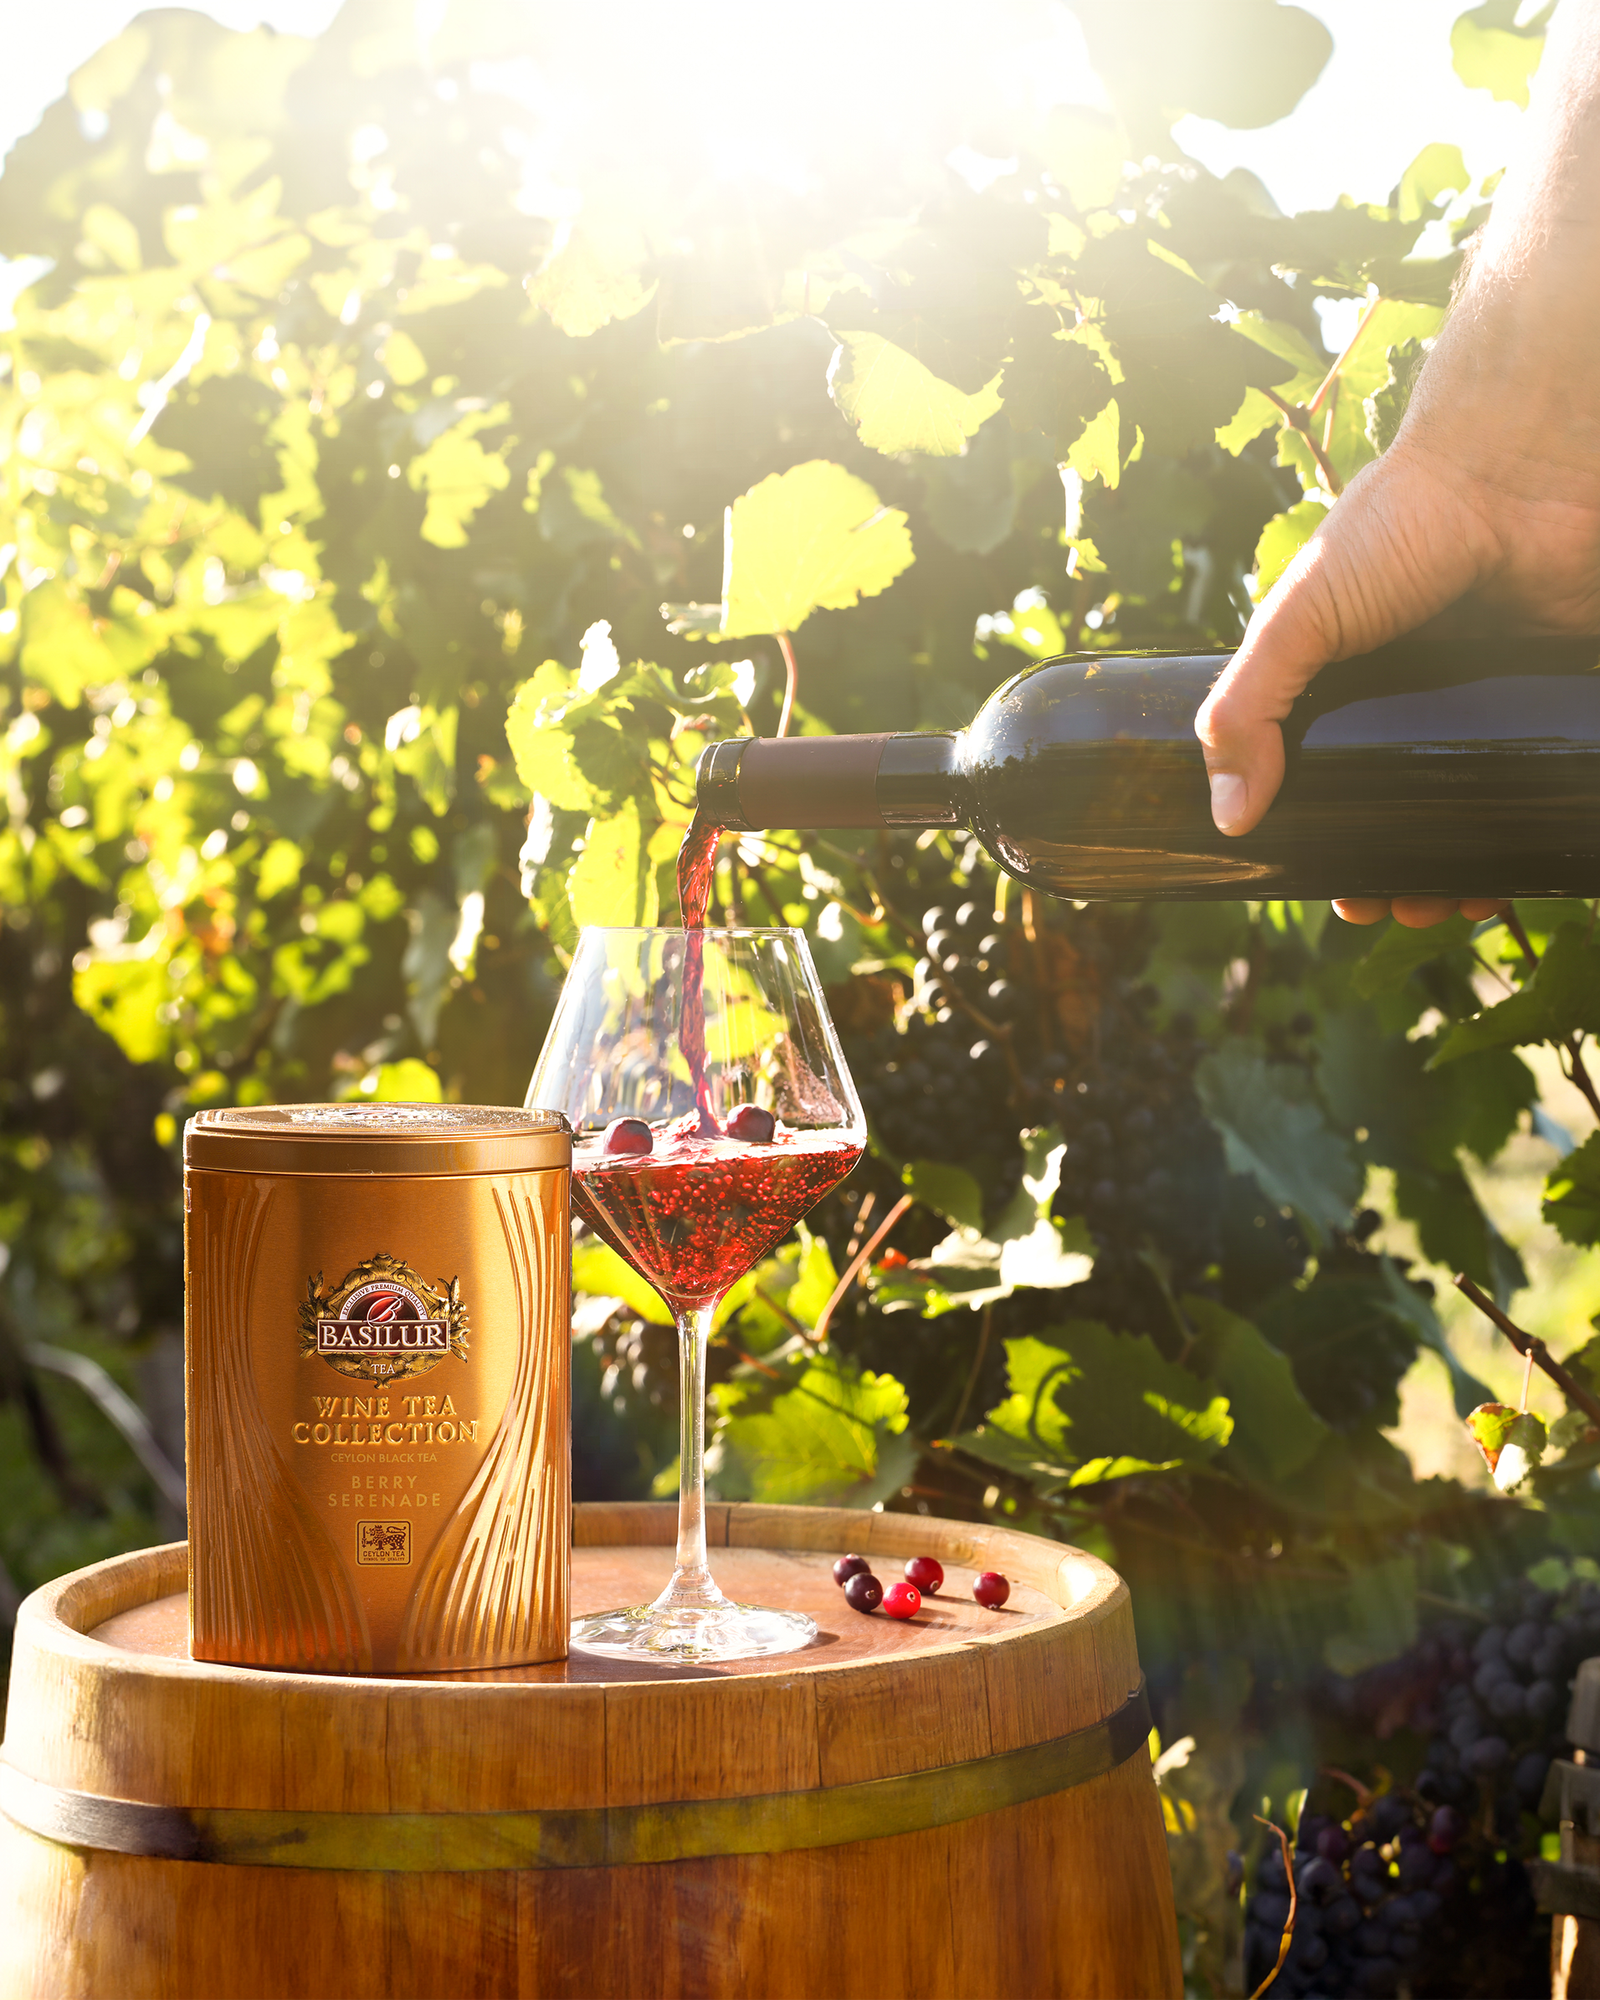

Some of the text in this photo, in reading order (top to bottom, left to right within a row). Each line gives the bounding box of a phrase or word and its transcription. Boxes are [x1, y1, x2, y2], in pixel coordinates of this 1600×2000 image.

[342, 1283, 426, 1316] EXCLUSIVE PREMIUM QUALITY
[321, 1324, 445, 1347] BASILUR
[371, 1364, 395, 1374] TEA
[312, 1394, 457, 1418] WINE TEA
[291, 1420, 479, 1445] COLLECTION
[331, 1453, 438, 1463] CEYLON BLACK TEA
[352, 1475, 418, 1489] BERRY
[328, 1493, 441, 1508] SERENADE
